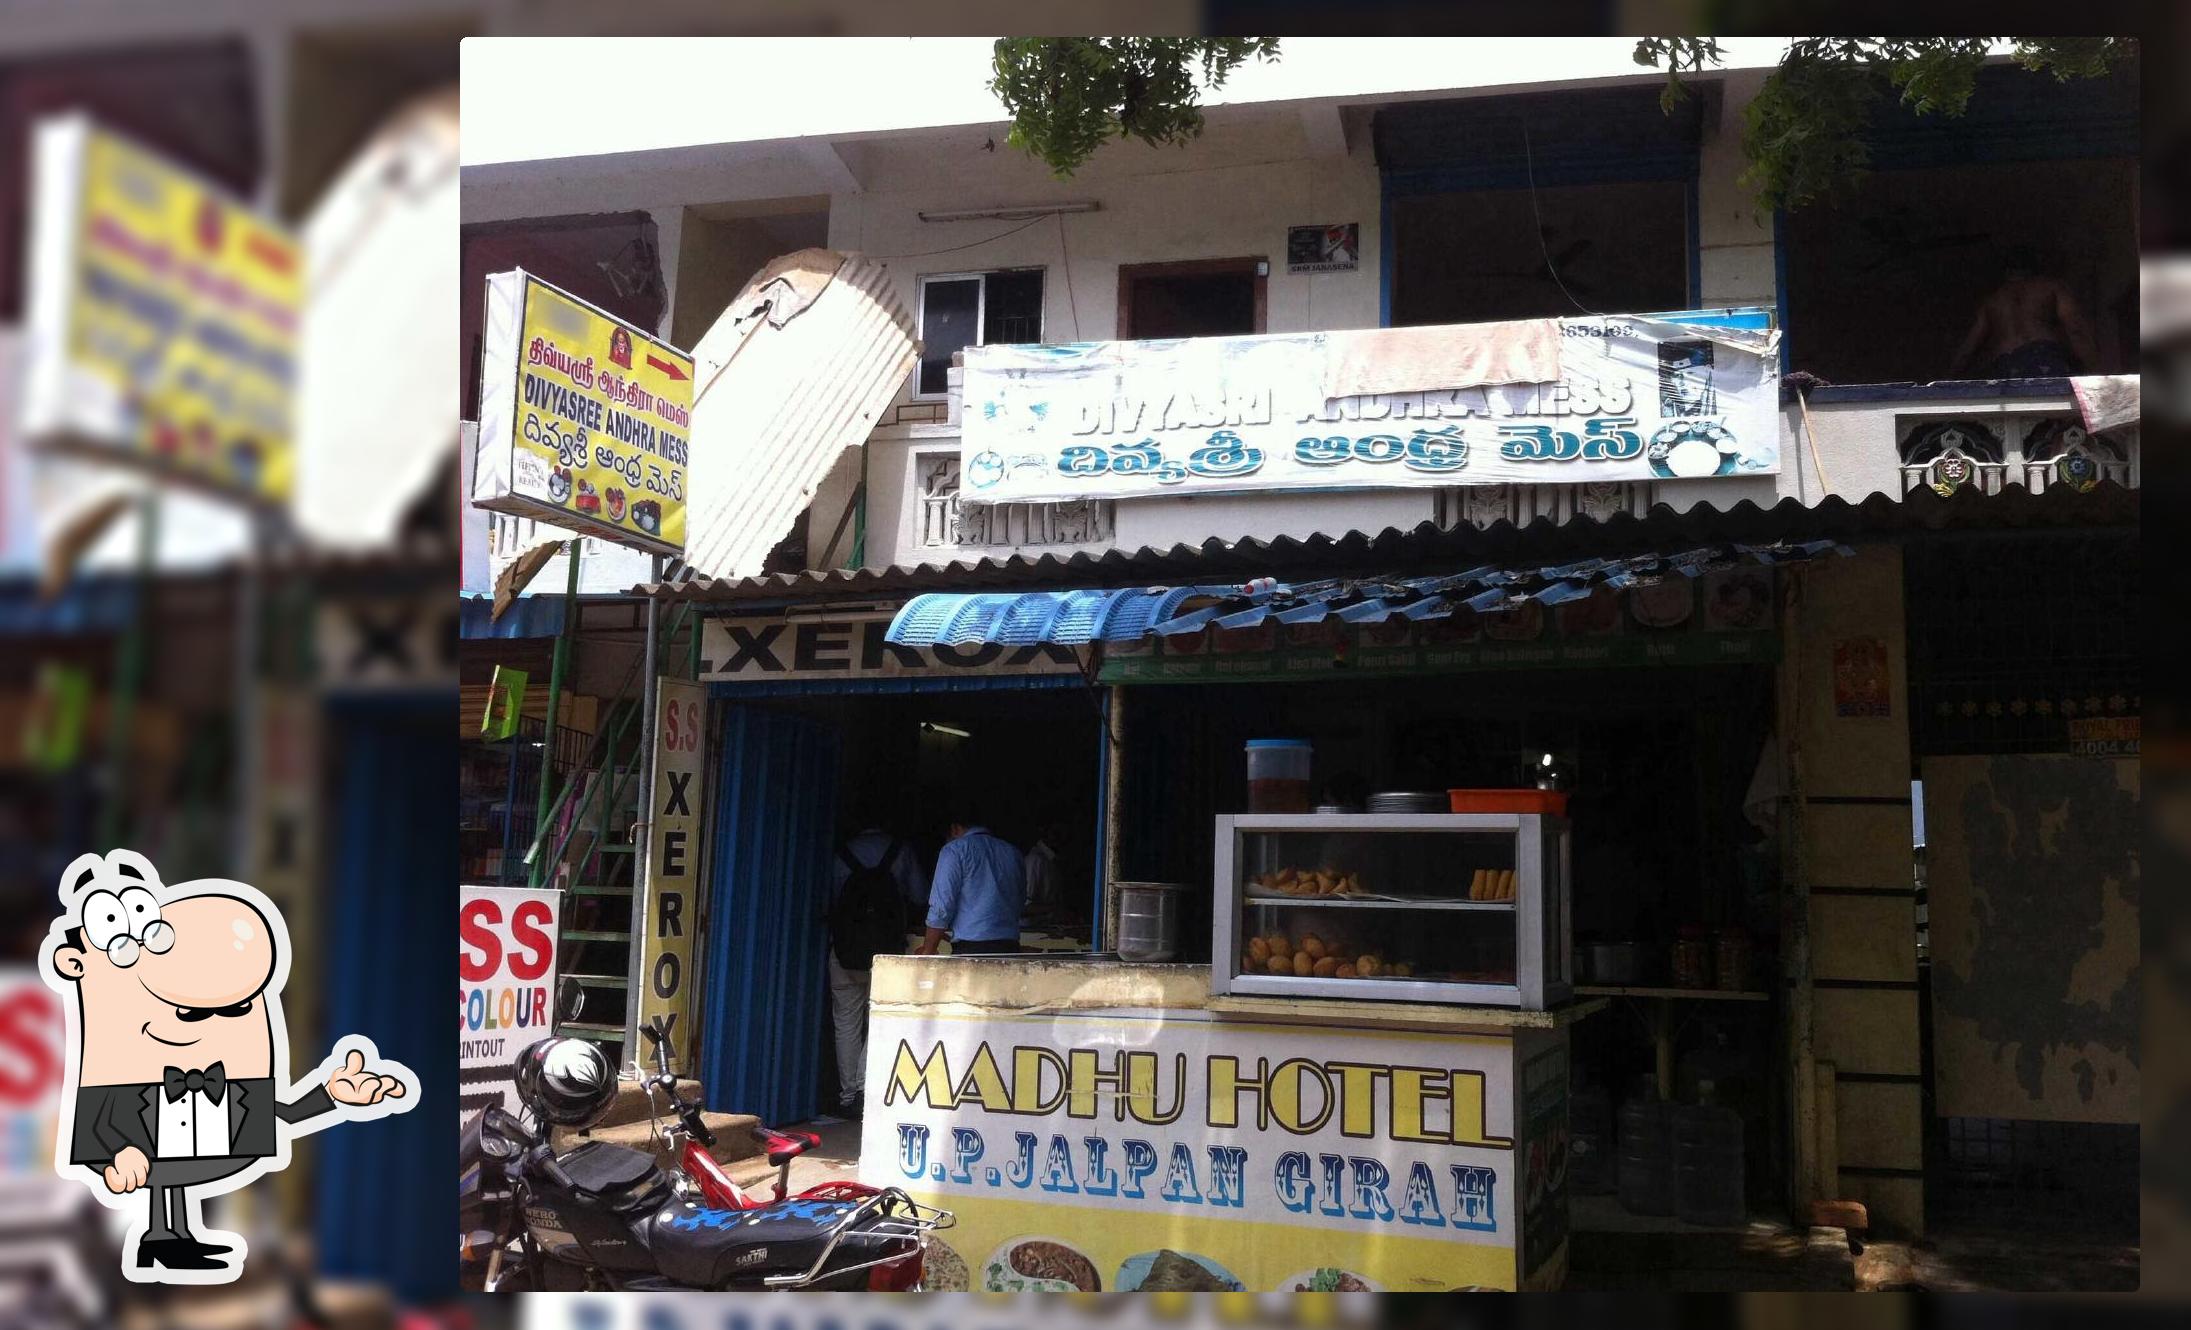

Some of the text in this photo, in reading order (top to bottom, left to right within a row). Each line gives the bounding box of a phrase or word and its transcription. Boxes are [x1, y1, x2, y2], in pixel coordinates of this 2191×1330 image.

[525, 373, 688, 467] DIVYASREE ANDHRA MESS
[598, 371, 653, 411] ஆந்திரா
[524, 413, 588, 468] దివ్యశ్రీ
[1057, 430, 1266, 483] దివ్యశ్రీ
[650, 770, 691, 1062] XEROX
[884, 1038, 1514, 1150] MADHU HOTEL
[1274, 1151, 1497, 1233] GIRAH
